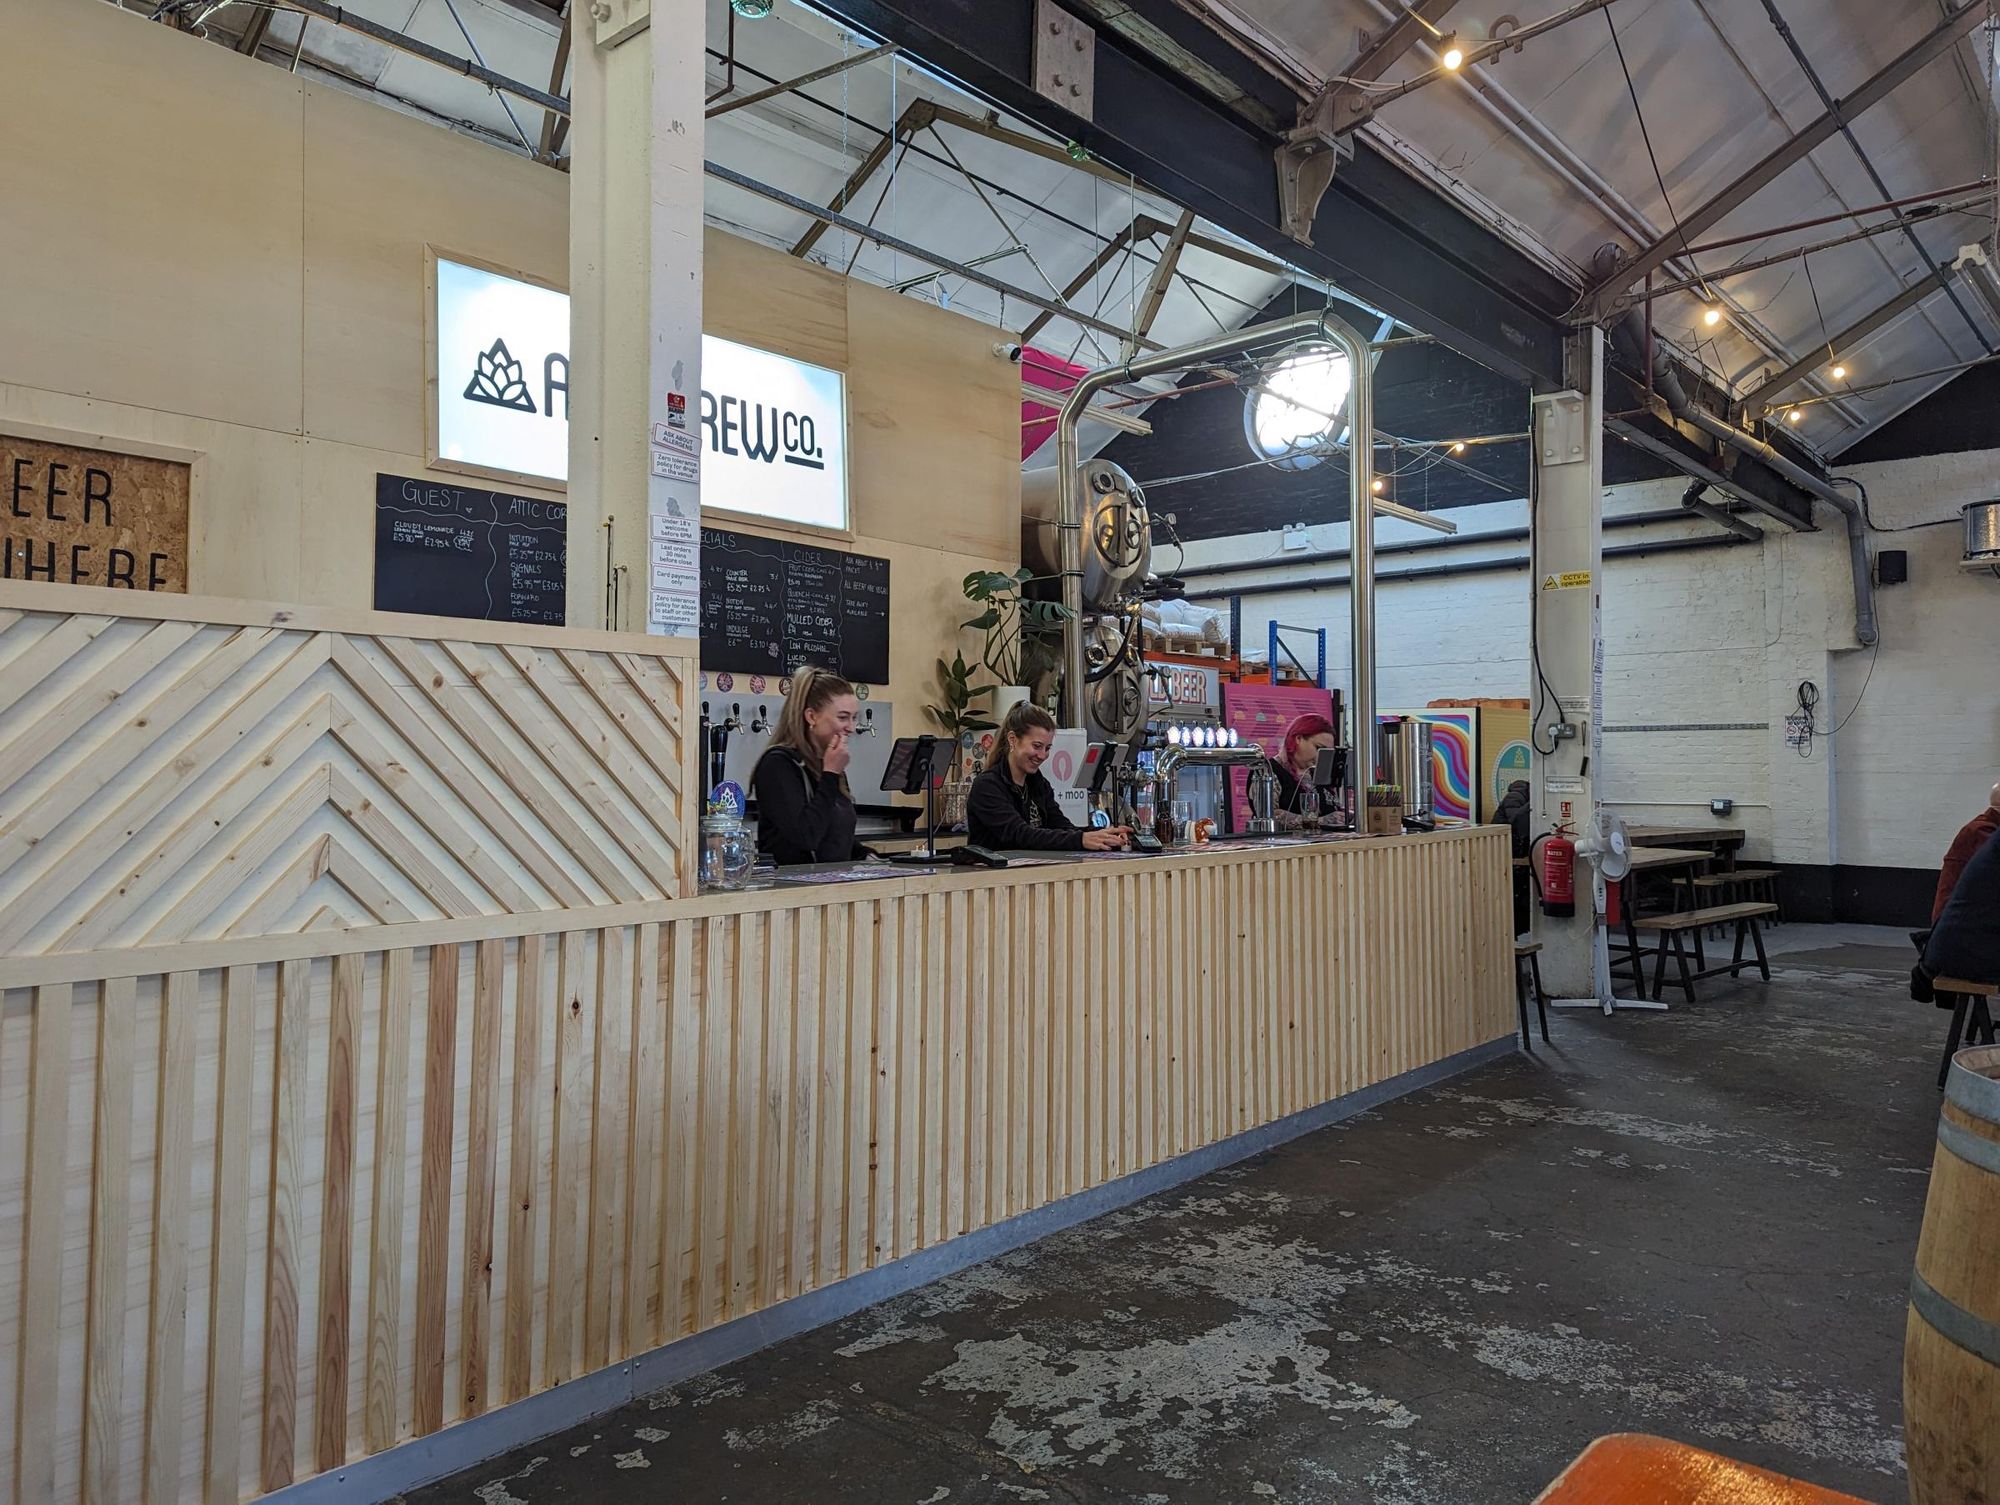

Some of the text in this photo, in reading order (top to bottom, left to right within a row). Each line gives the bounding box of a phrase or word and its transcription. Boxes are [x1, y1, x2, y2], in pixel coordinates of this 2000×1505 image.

[662, 436, 693, 452] ALLERGENS
[664, 430, 693, 445] ASK ABOUT
[656, 461, 672, 469] policy
[683, 464, 698, 474] drugs
[672, 456, 697, 467] tolerance
[12, 458, 112, 526] EER
[402, 480, 465, 511] GUEST
[508, 498, 540, 517] ATTIC
[395, 521, 421, 530] CLOUDY
[424, 525, 455, 534] LEMONADE
[678, 558, 692, 566] close
[794, 550, 822, 564] CIDER
[4, 537, 169, 592] HERE
[510, 562, 542, 575] SIGNALS
[787, 613, 834, 628] MULLED CIDER
[787, 654, 806, 662] LUCID
[1171, 668, 1207, 704] BEER
[1065, 791, 1085, 799] moo
